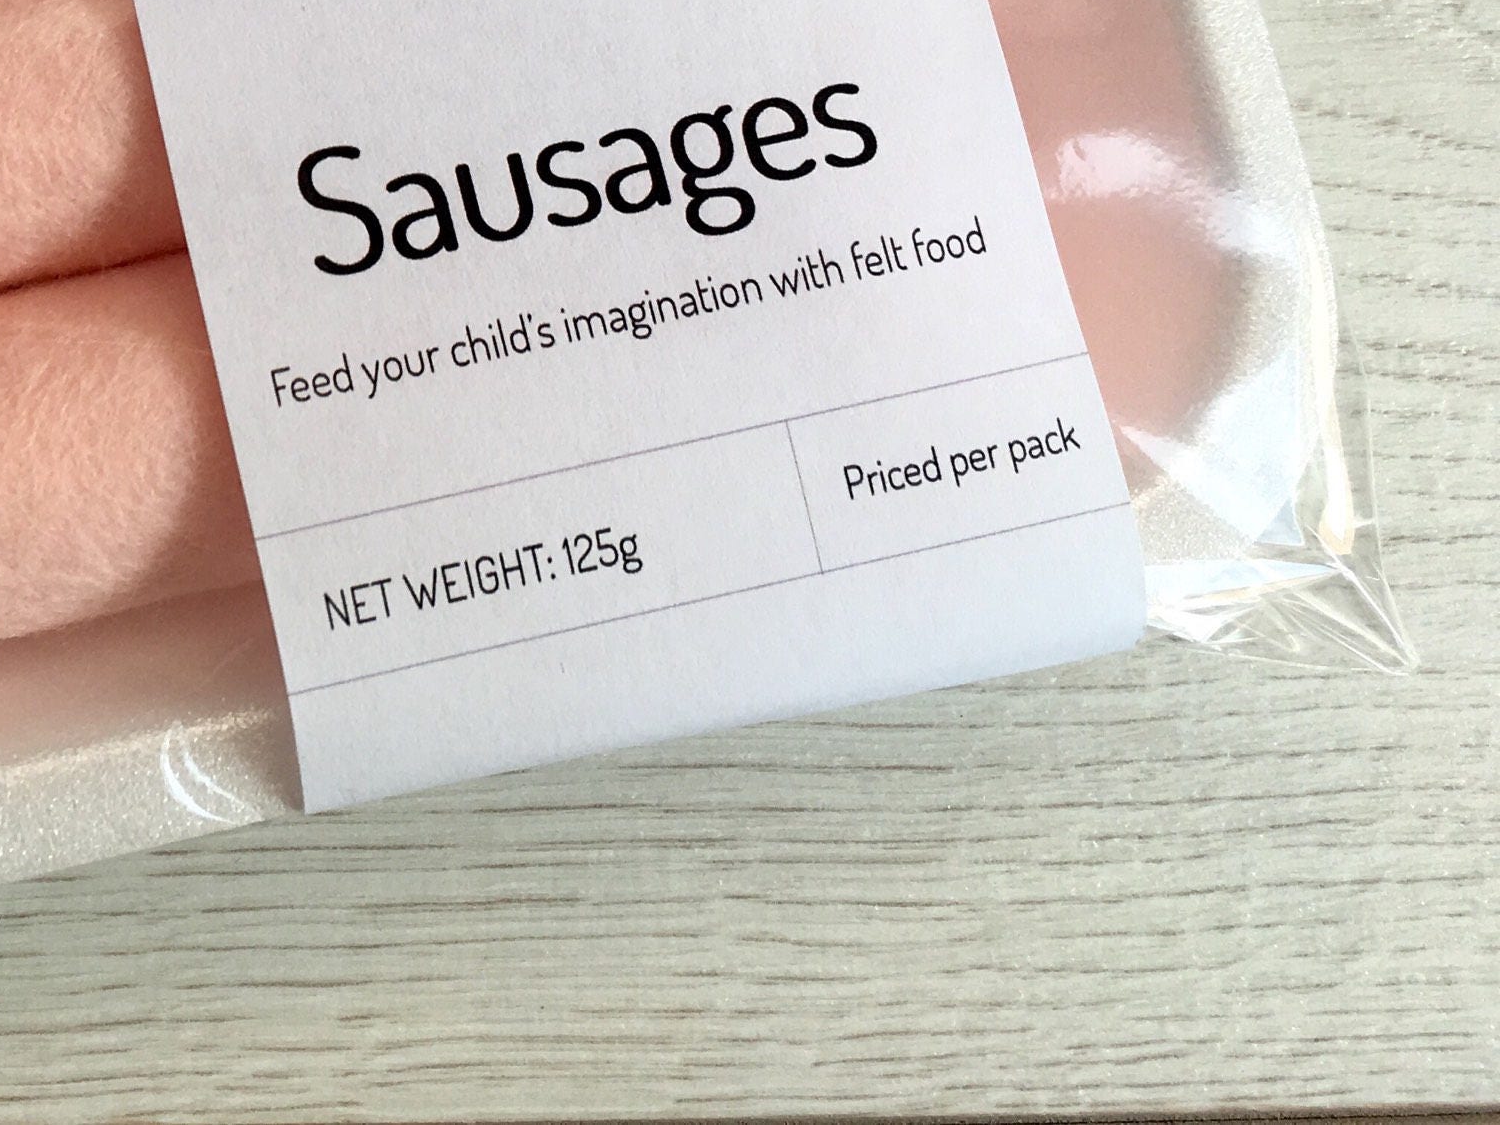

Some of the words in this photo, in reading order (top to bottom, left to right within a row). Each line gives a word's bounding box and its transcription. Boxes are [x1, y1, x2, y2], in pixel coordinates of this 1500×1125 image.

[296, 82, 879, 276] Sausages
[270, 351, 355, 409] Feed
[360, 346, 440, 400] your
[450, 312, 557, 368] child's
[559, 275, 764, 344] imagination
[768, 247, 846, 298] with
[849, 234, 909, 281] felt
[911, 214, 988, 268] food
[842, 444, 943, 501] Priced
[949, 444, 999, 489] per
[1007, 416, 1081, 475] pack
[322, 576, 393, 632] NET
[401, 542, 557, 611] WEIGHT:
[561, 526, 644, 576] 125g
